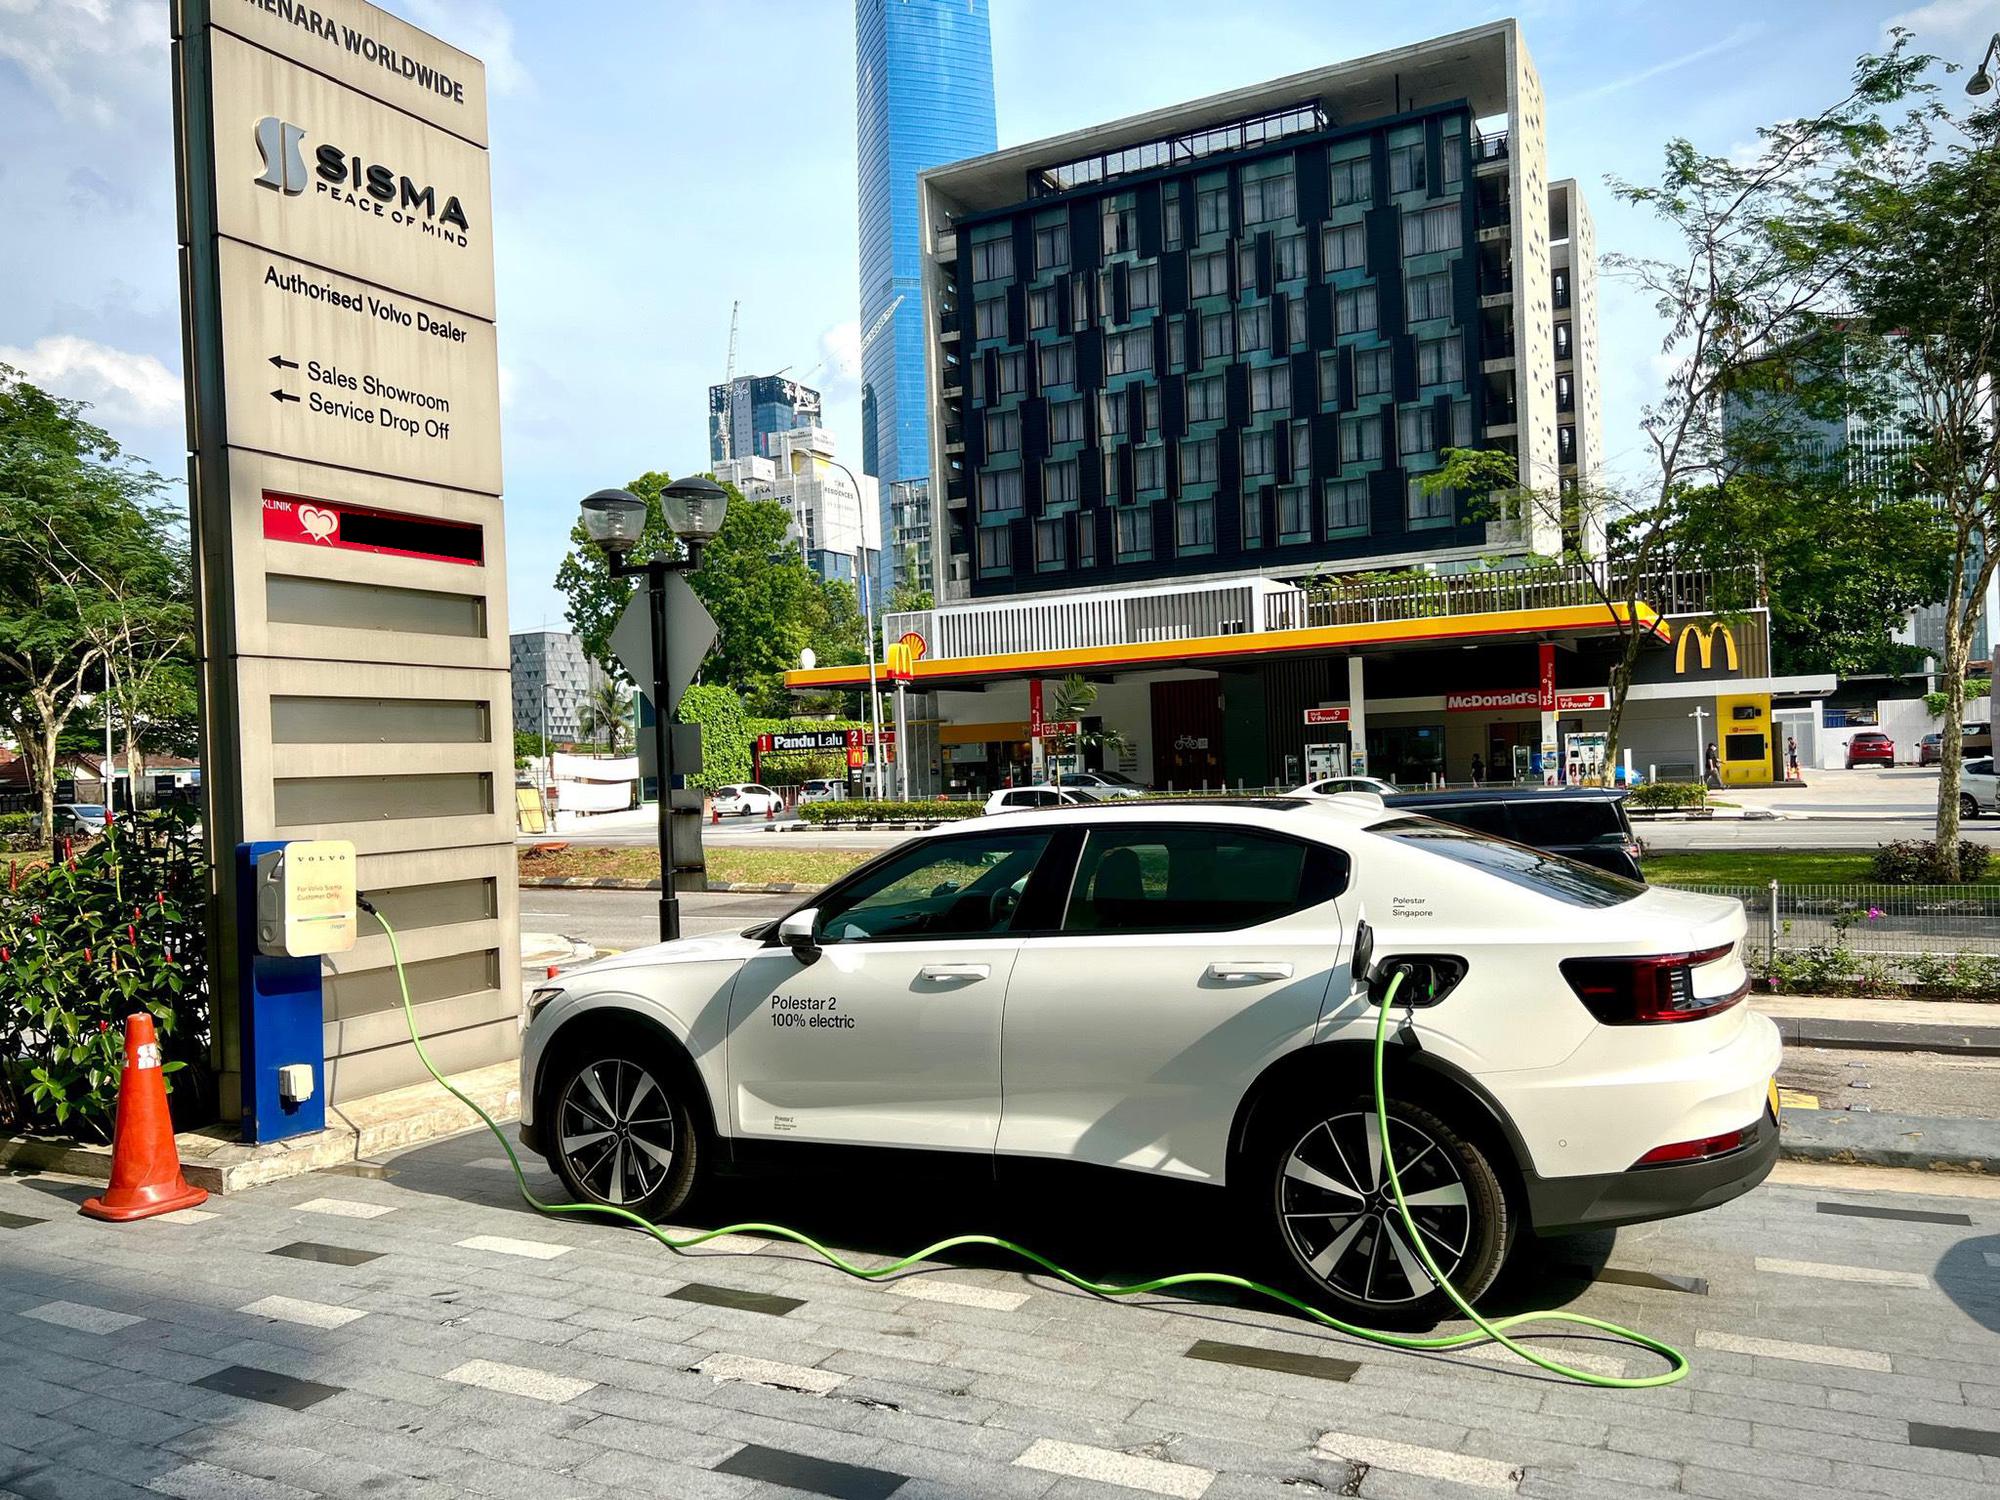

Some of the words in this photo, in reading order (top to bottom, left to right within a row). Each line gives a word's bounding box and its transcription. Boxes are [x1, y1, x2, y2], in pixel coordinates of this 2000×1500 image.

[245, 0, 339, 46] ENARA
[341, 25, 464, 105] WORLDWIDE
[315, 144, 470, 234] SISMA
[316, 182, 385, 217] PEACE
[391, 210, 416, 227] OF
[422, 221, 468, 248] MIND
[264, 265, 363, 312] Authorised
[367, 296, 412, 326] Volvo
[417, 312, 467, 343] Dealer
[307, 361, 358, 391] Sales
[363, 375, 450, 413] Showroom
[309, 392, 375, 424] Service
[380, 408, 420, 437] Drop
[425, 419, 450, 440] Off
[261, 499, 292, 512] KLINIK
[1448, 692, 1538, 709] McDonald's
[760, 735, 766, 746] 1
[774, 735, 816, 749] Pandu
[818, 734, 843, 747] Lalu
[850, 730, 858, 742] 2
[297, 855, 346, 863] VOLVO
[1392, 909, 1433, 918] Singapore
[771, 995, 826, 1010] Polestar
[828, 997, 837, 1011] 2
[771, 1013, 806, 1028] 100%
[809, 1014, 856, 1029] electric
